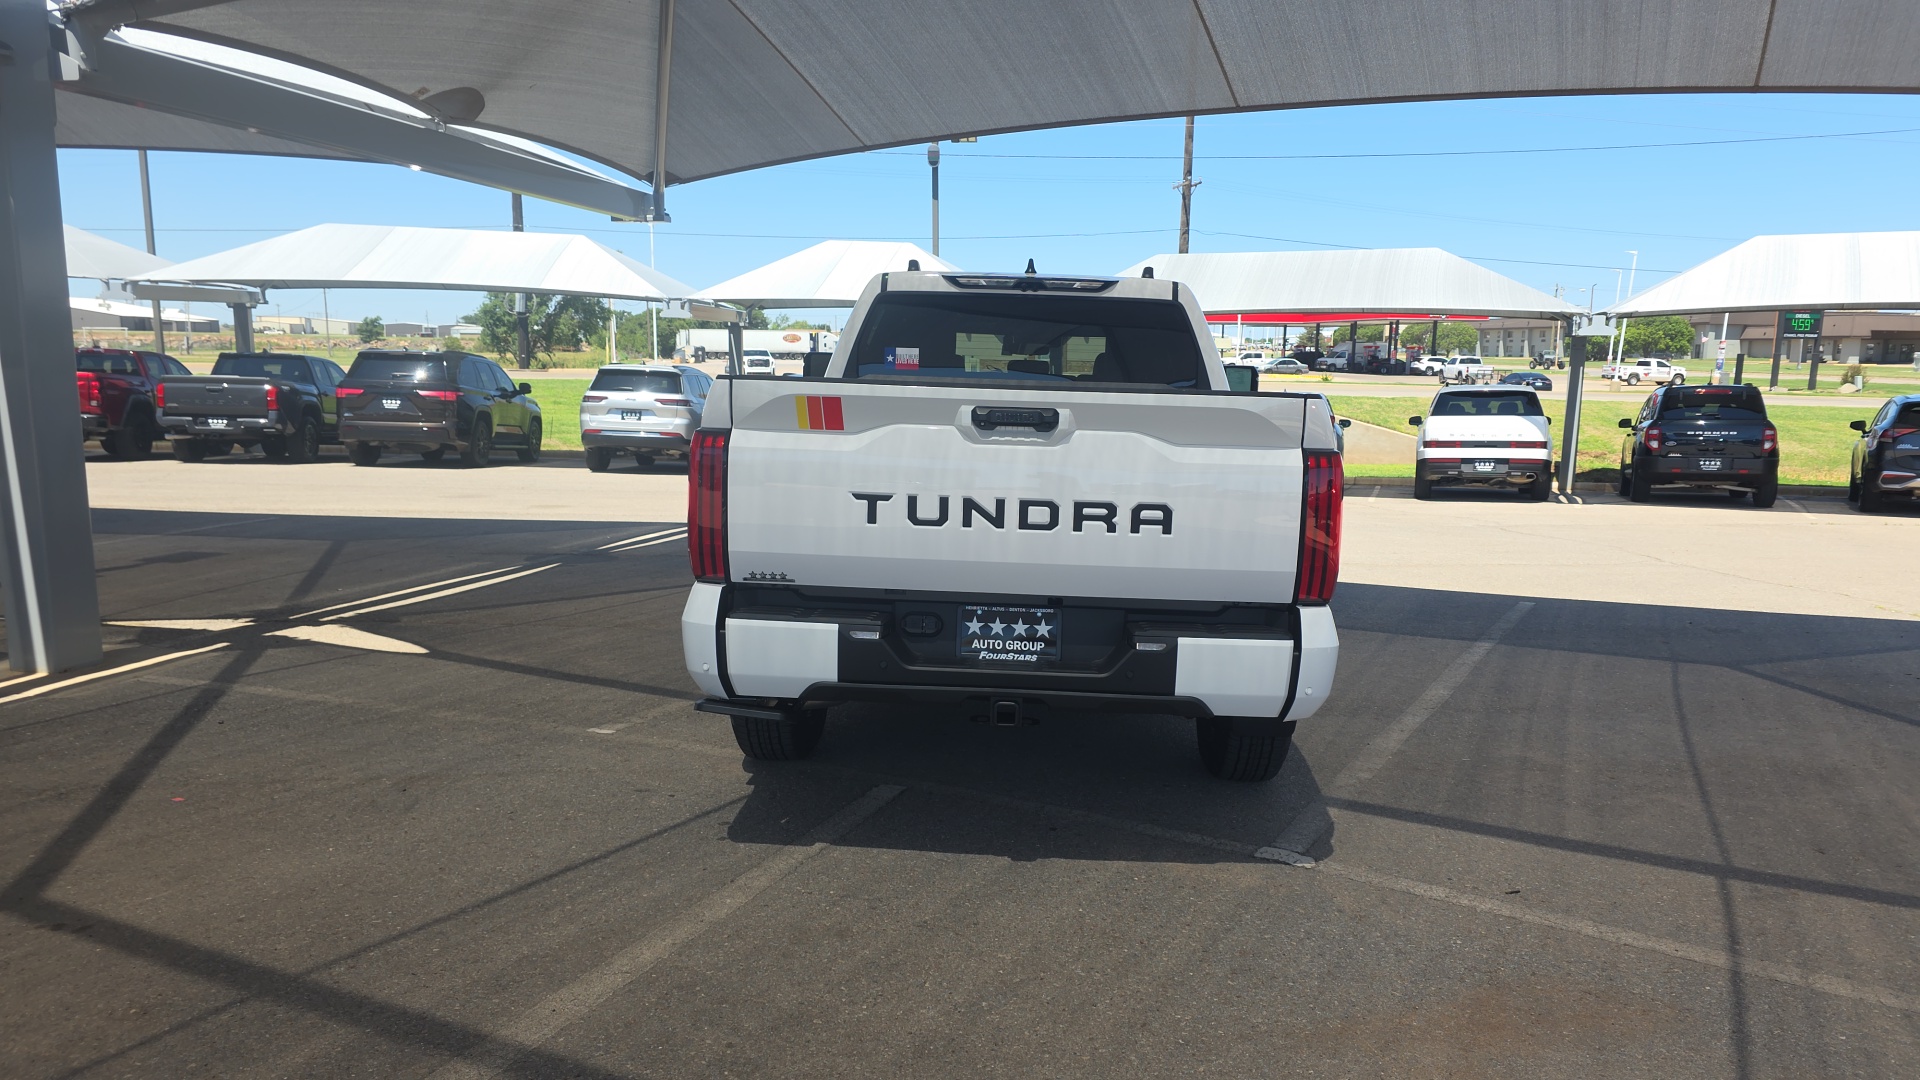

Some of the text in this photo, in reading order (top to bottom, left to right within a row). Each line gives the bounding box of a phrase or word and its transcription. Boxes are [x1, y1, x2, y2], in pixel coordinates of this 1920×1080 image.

[850, 492, 1174, 535] TUNDRA
[971, 639, 1045, 651] AUTO GROUP
